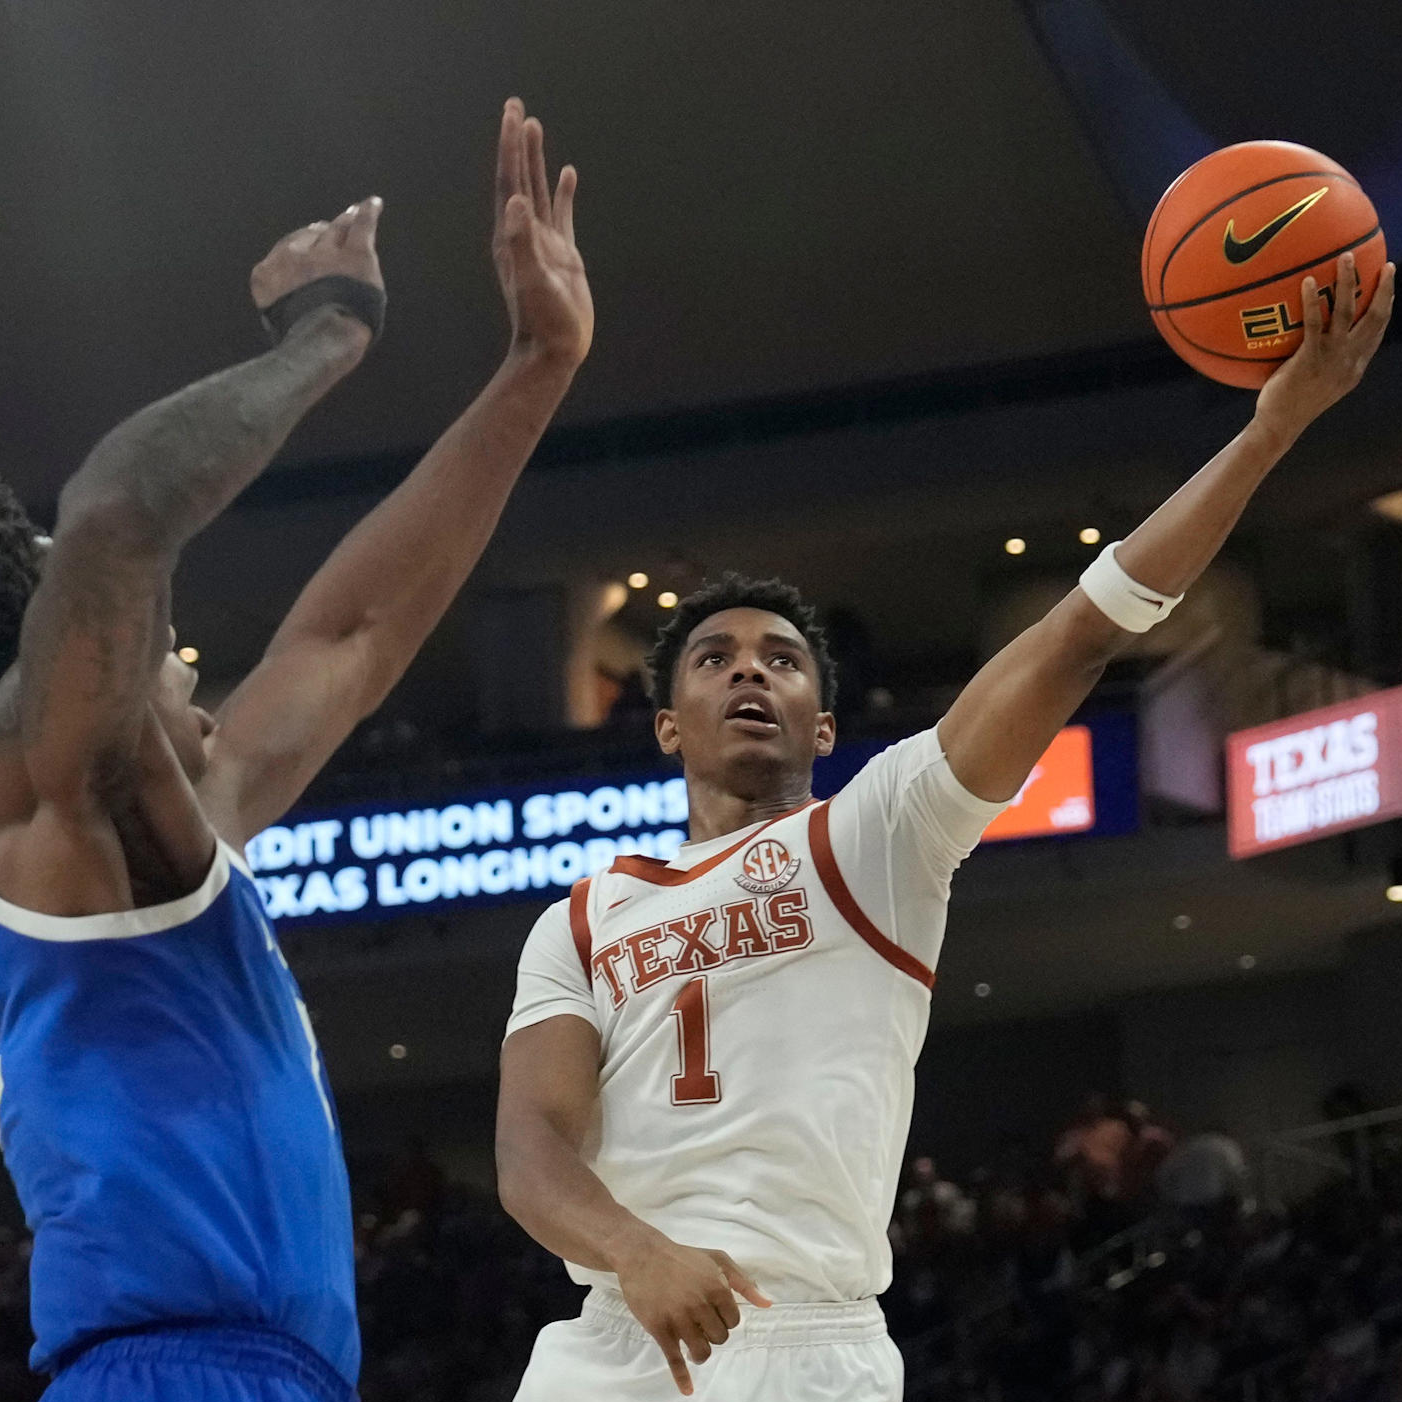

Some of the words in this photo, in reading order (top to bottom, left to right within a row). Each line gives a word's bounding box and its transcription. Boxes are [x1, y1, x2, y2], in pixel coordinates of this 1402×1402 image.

[1247, 712, 1379, 797] TEXAS
[350, 800, 513, 859] UNION
[744, 840, 789, 882] SEC
[590, 887, 815, 1011] TEXAS
[669, 974, 722, 1107] 1
